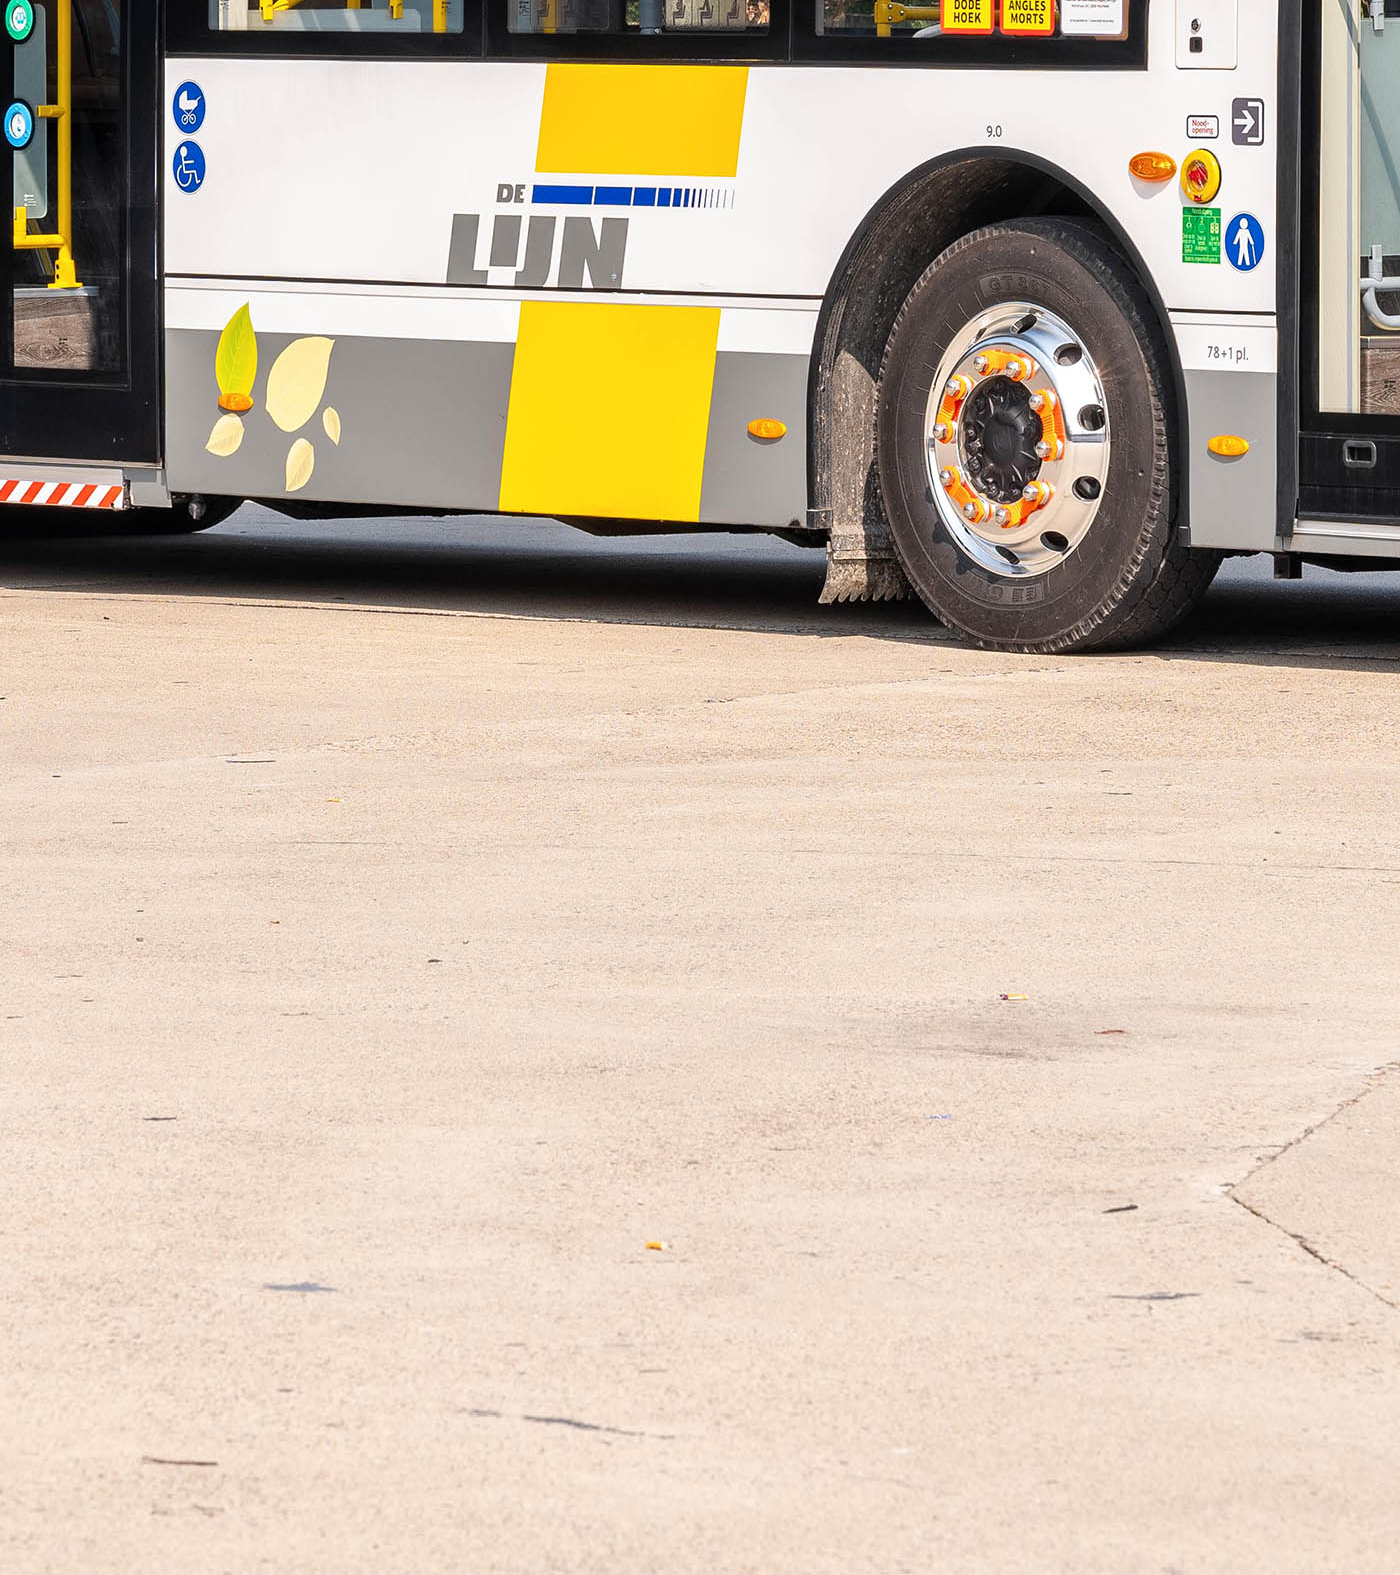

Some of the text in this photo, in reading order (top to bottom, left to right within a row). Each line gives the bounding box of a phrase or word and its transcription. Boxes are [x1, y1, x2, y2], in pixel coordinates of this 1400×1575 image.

[954, 0, 981, 10] DODE
[1008, 0, 1046, 11] ANGLES
[953, 12, 981, 23] HOEK
[1010, 13, 1044, 24] MORTS
[986, 125, 1003, 138] 9.0
[496, 183, 526, 204] DE
[1207, 345, 1249, 365] 78+1 pl.
